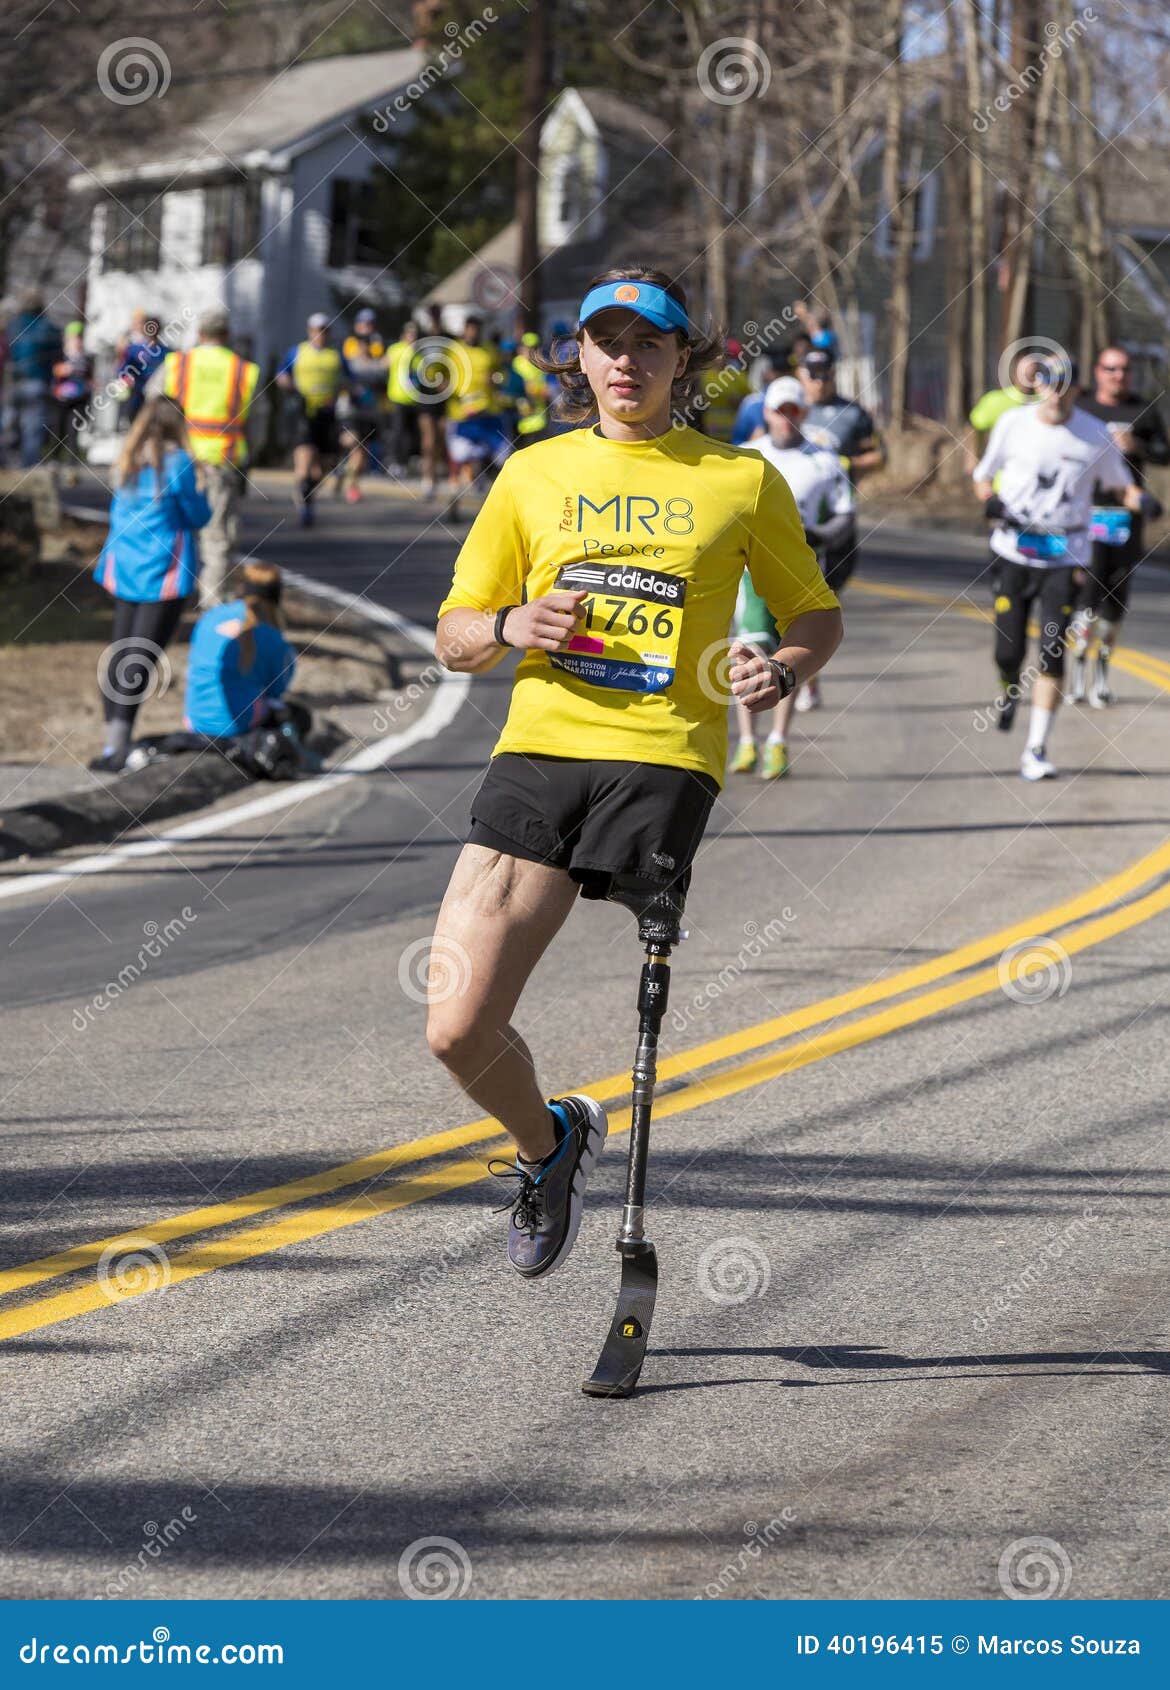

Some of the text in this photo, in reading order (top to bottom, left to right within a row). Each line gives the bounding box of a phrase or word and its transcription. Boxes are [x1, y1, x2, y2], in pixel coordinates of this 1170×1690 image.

[559, 496, 573, 532] Team
[577, 494, 694, 535] MR8
[583, 539, 665, 558] Peace
[607, 571, 679, 598] adidas
[580, 661, 607, 670] BOSTON
